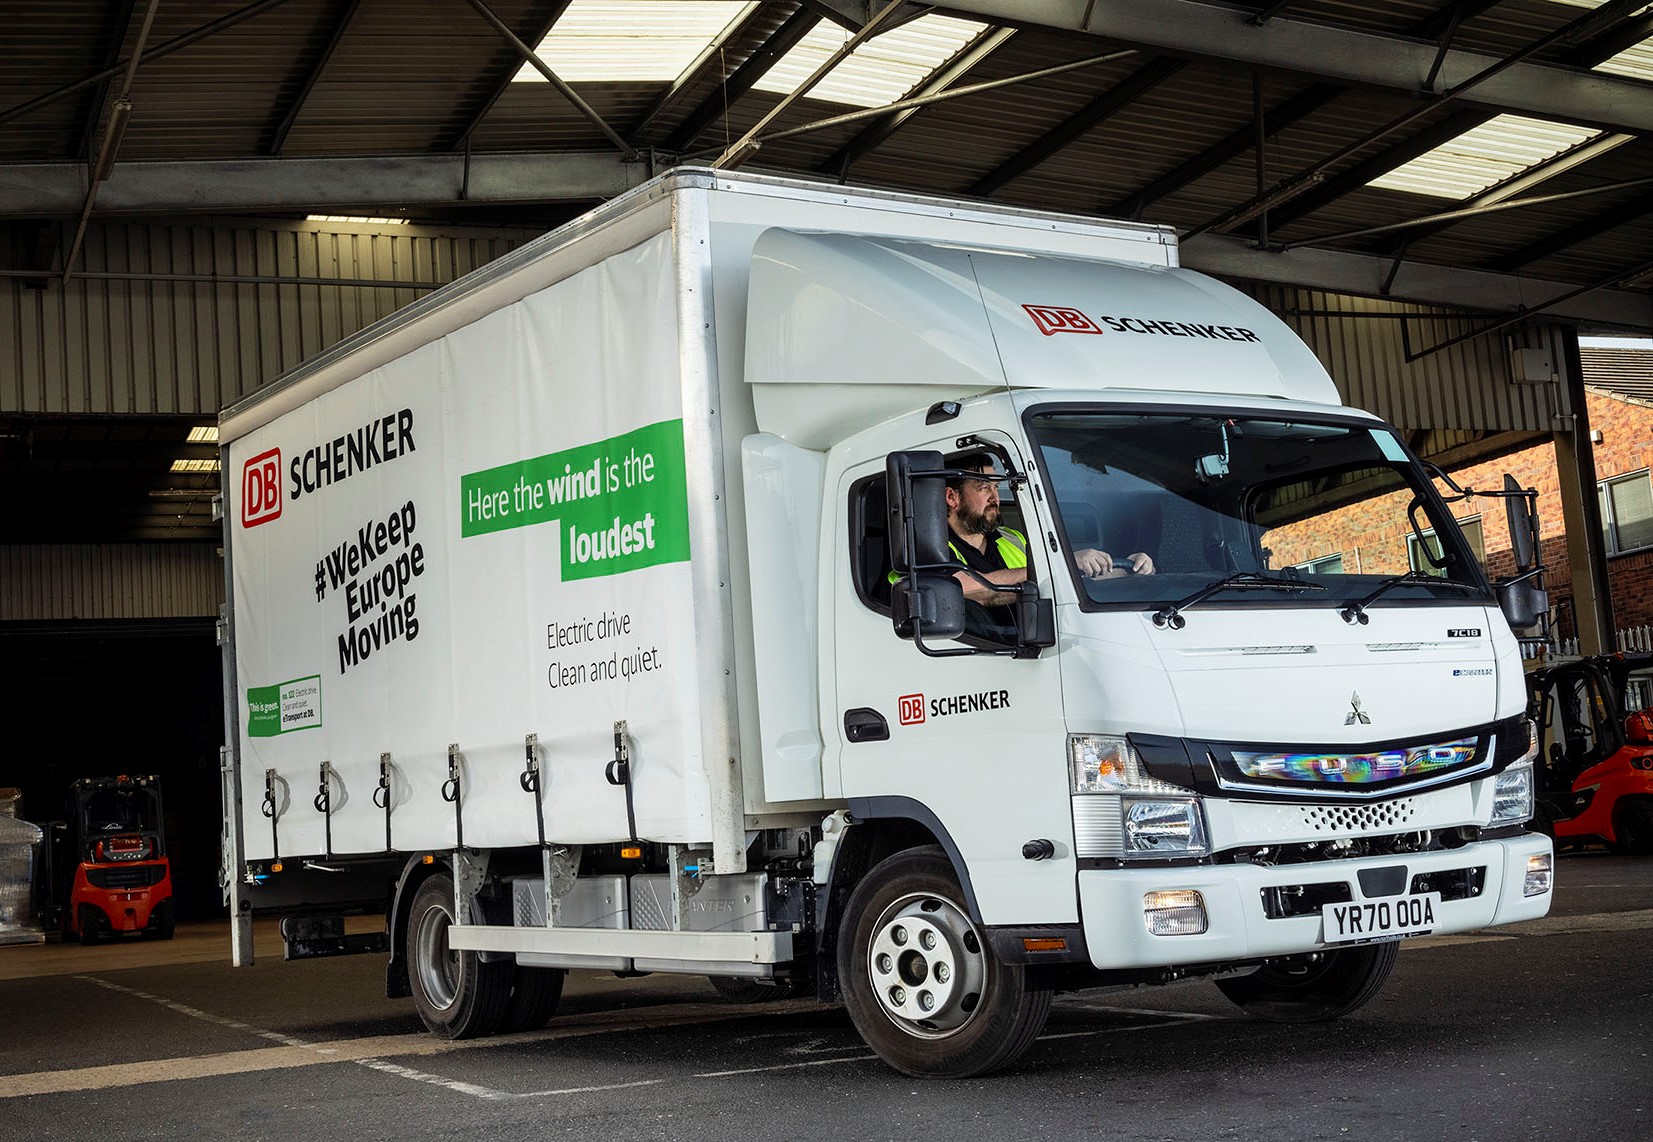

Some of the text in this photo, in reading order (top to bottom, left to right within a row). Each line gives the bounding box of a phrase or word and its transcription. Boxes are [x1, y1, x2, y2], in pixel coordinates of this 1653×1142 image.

[1030, 306, 1262, 343] DB SCHENKER
[246, 408, 416, 519] DB SCHENKER
[468, 447, 655, 523] Here the wind is the
[315, 500, 416, 602] #WeKeep
[569, 513, 656, 564] loudest
[345, 543, 425, 623] Europe
[338, 593, 420, 674] Moving
[547, 610, 631, 650] Electric drive
[1451, 629, 1479, 637] 7C18
[548, 646, 662, 689] Clean and quiet.
[250, 703, 260, 712] This
[900, 690, 1011, 722] DB SCHENKER
[1257, 747, 1457, 775] FUSO
[1334, 902, 1391, 935] YR70
